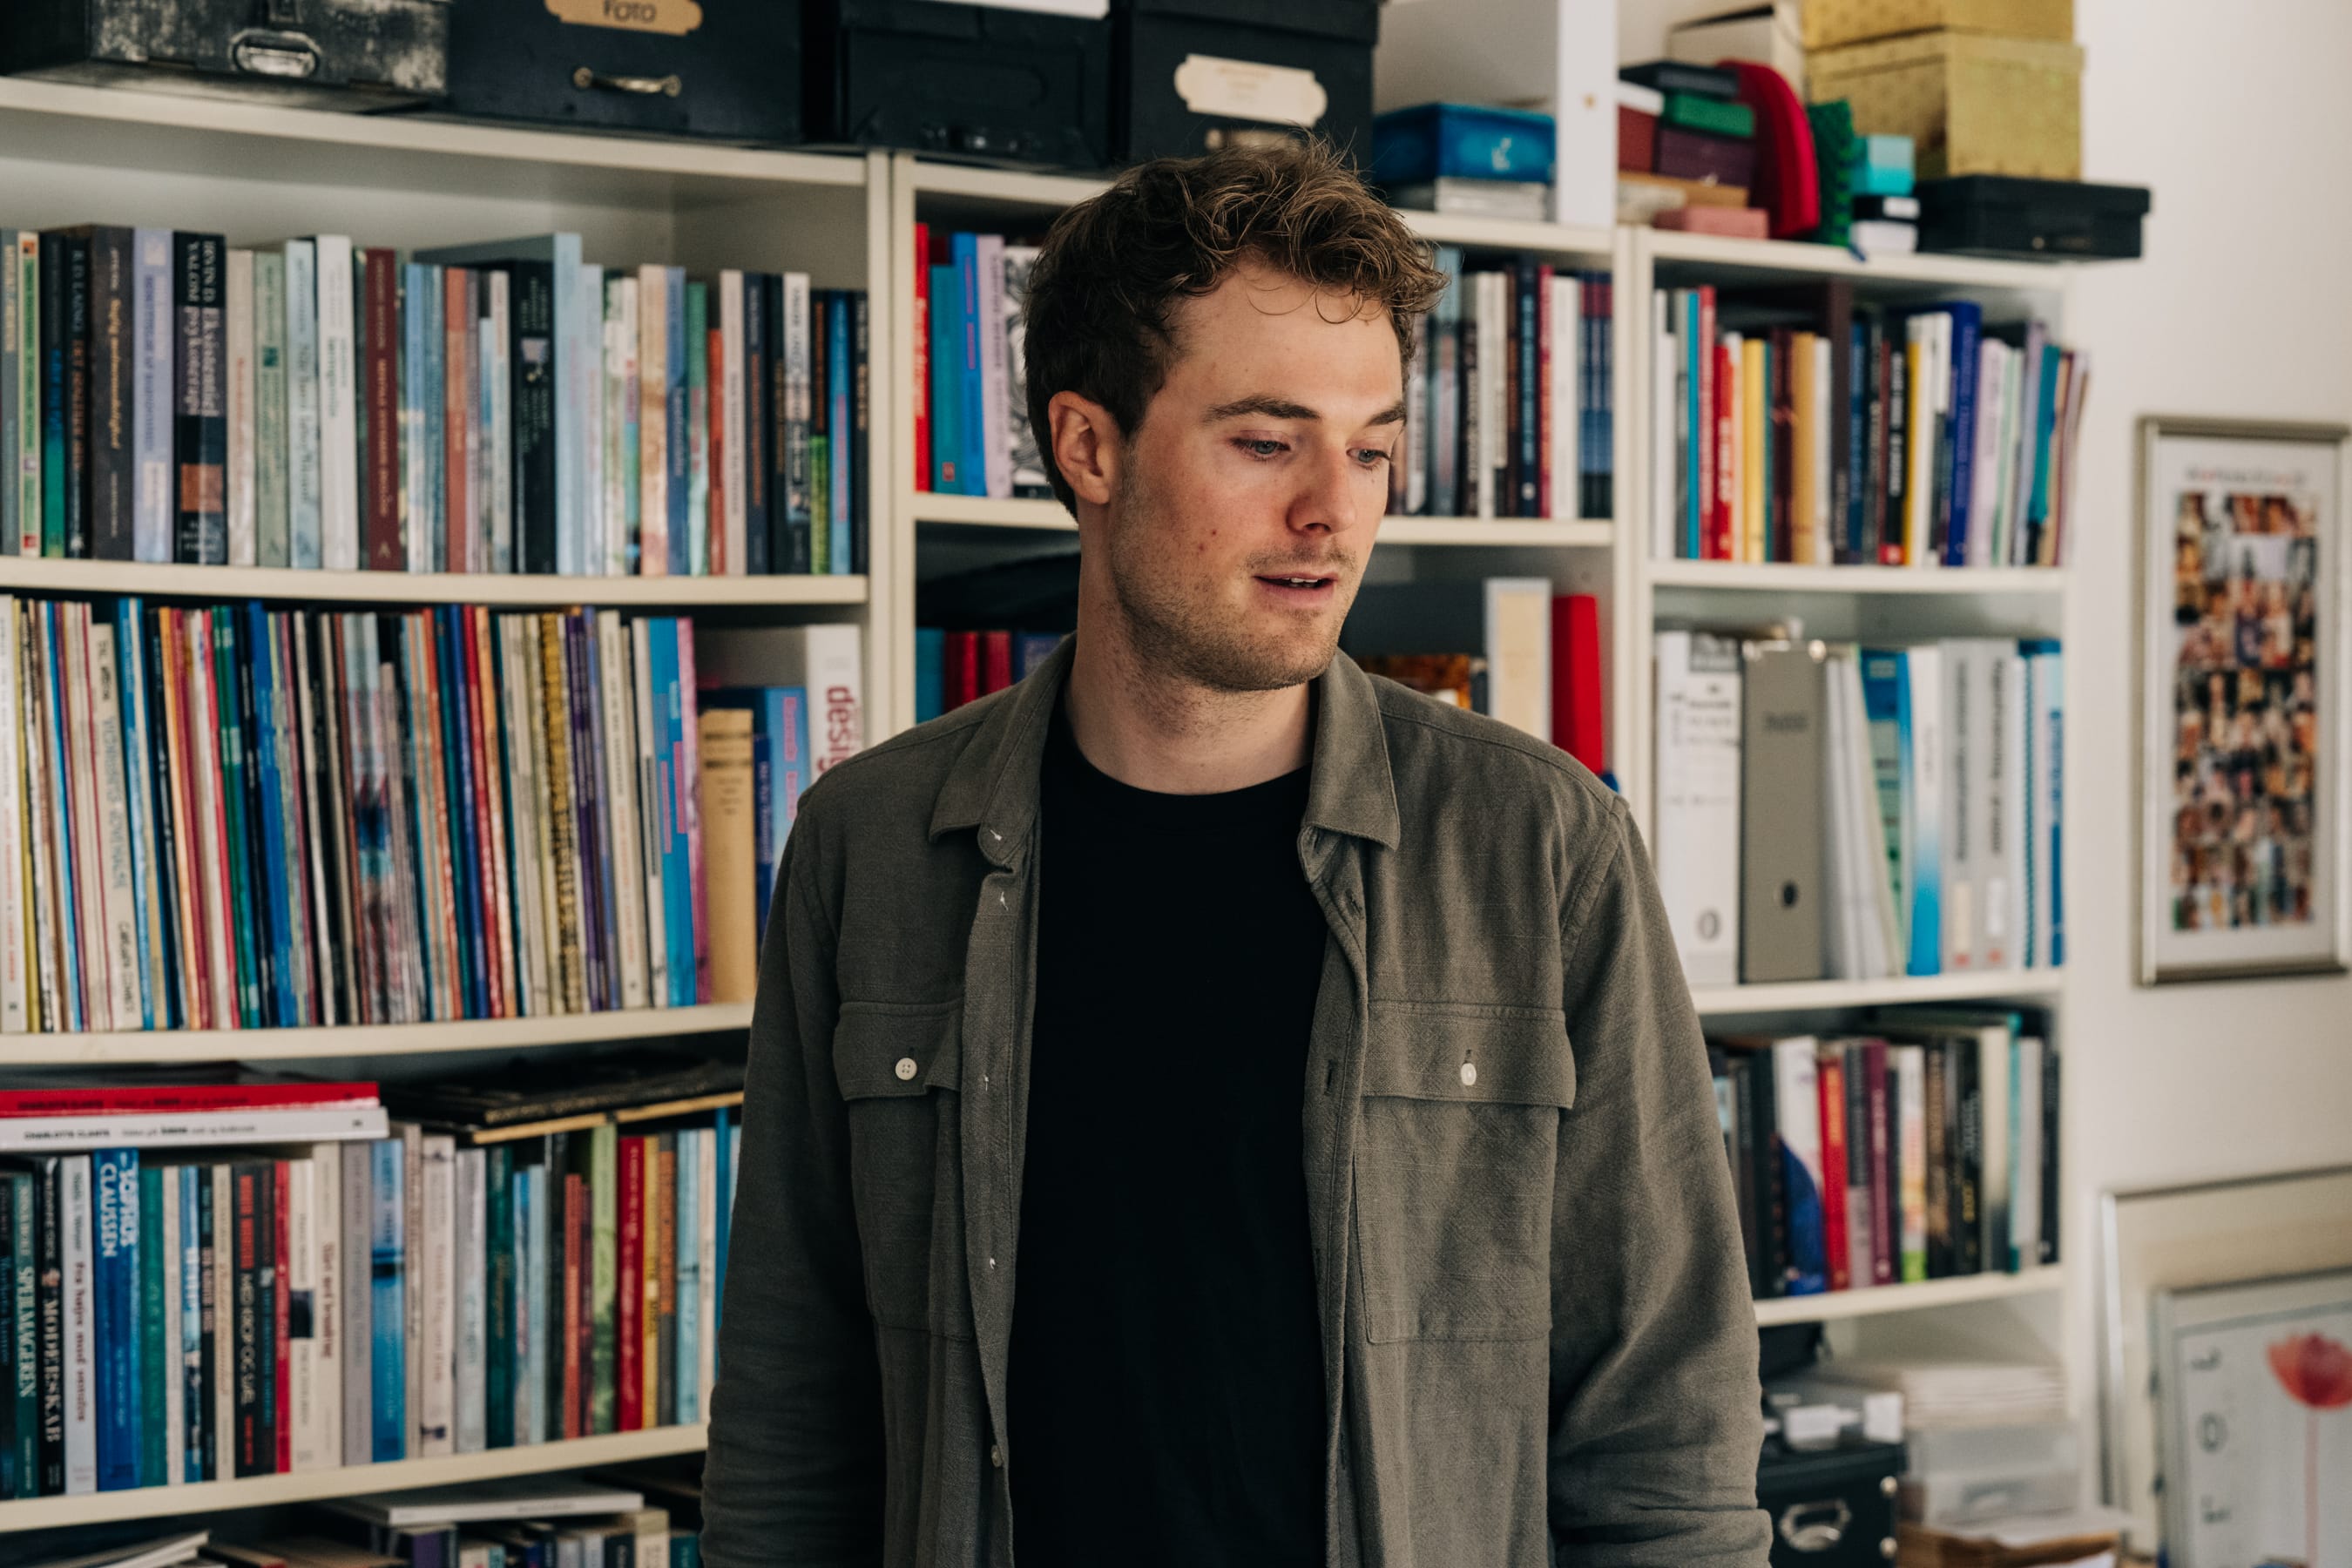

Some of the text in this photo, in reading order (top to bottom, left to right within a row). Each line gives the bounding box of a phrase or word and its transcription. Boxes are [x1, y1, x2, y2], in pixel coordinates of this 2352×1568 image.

[100, 1163, 118, 1259] CLAUSSEN
[75, 1261, 87, 1285] Fra
[44, 1298, 62, 1443] MODERSKAB
